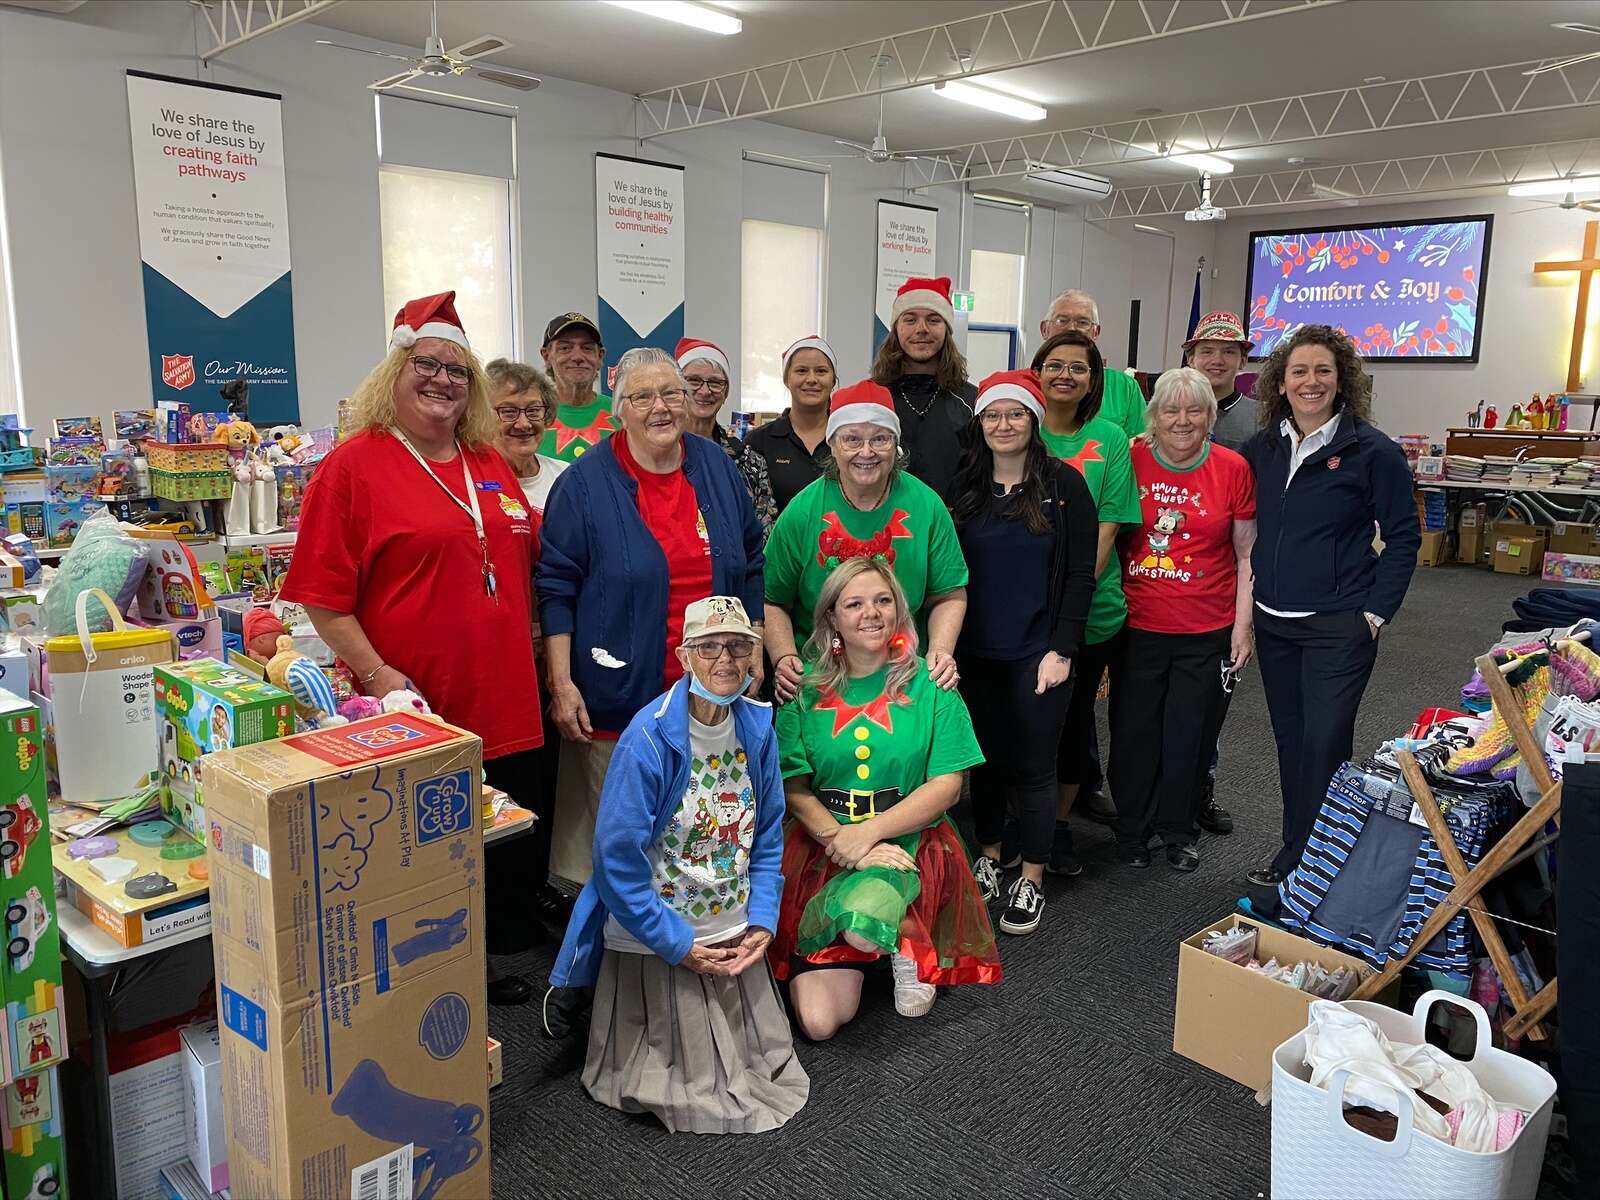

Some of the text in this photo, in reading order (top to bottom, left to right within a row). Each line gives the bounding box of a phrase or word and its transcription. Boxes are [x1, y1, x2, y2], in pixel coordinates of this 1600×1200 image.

[161, 108, 255, 134] We share the
[152, 123, 265, 153] love of Jesus by
[163, 145, 258, 166] creating faith
[178, 163, 246, 183] pathways
[614, 180, 667, 197] We share the
[165, 204, 185, 212] Taking
[608, 193, 673, 211] love of Jesus by
[608, 206, 673, 224] building healthy
[615, 221, 668, 235] communities
[890, 221, 898, 230] We
[916, 225, 925, 234] the
[882, 242, 904, 252] working
[886, 231, 897, 239] love
[905, 233, 920, 242] Jesus
[922, 236, 928, 246] by
[1283, 278, 1440, 303] Comfort & Joy
[167, 357, 180, 368] THE
[205, 361, 288, 376] Our Mission
[1152, 482, 1178, 494] HAVE
[1154, 492, 1189, 504] SWEET
[1129, 560, 1191, 582] CHRISTMAS
[178, 631, 203, 639] vtech
[120, 656, 145, 665] anko
[123, 682, 149, 690] Shape
[166, 689, 187, 711] duplo
[276, 720, 286, 737] dup
[16, 717, 31, 770] LEGO duplo
[1330, 781, 1366, 805] OEPROOF
[442, 786, 454, 825] Grow
[396, 768, 412, 867] Imaginations At Play
[430, 807, 440, 824] up
[149, 924, 171, 936] Let's
[173, 917, 195, 928] Read
[326, 907, 335, 931] Sube
[336, 904, 345, 941] Grimper
[338, 944, 346, 954] et
[328, 942, 338, 977] Lánzate
[349, 947, 359, 971] Climb
[336, 956, 348, 983] glisser
[352, 984, 361, 1007] Slide
